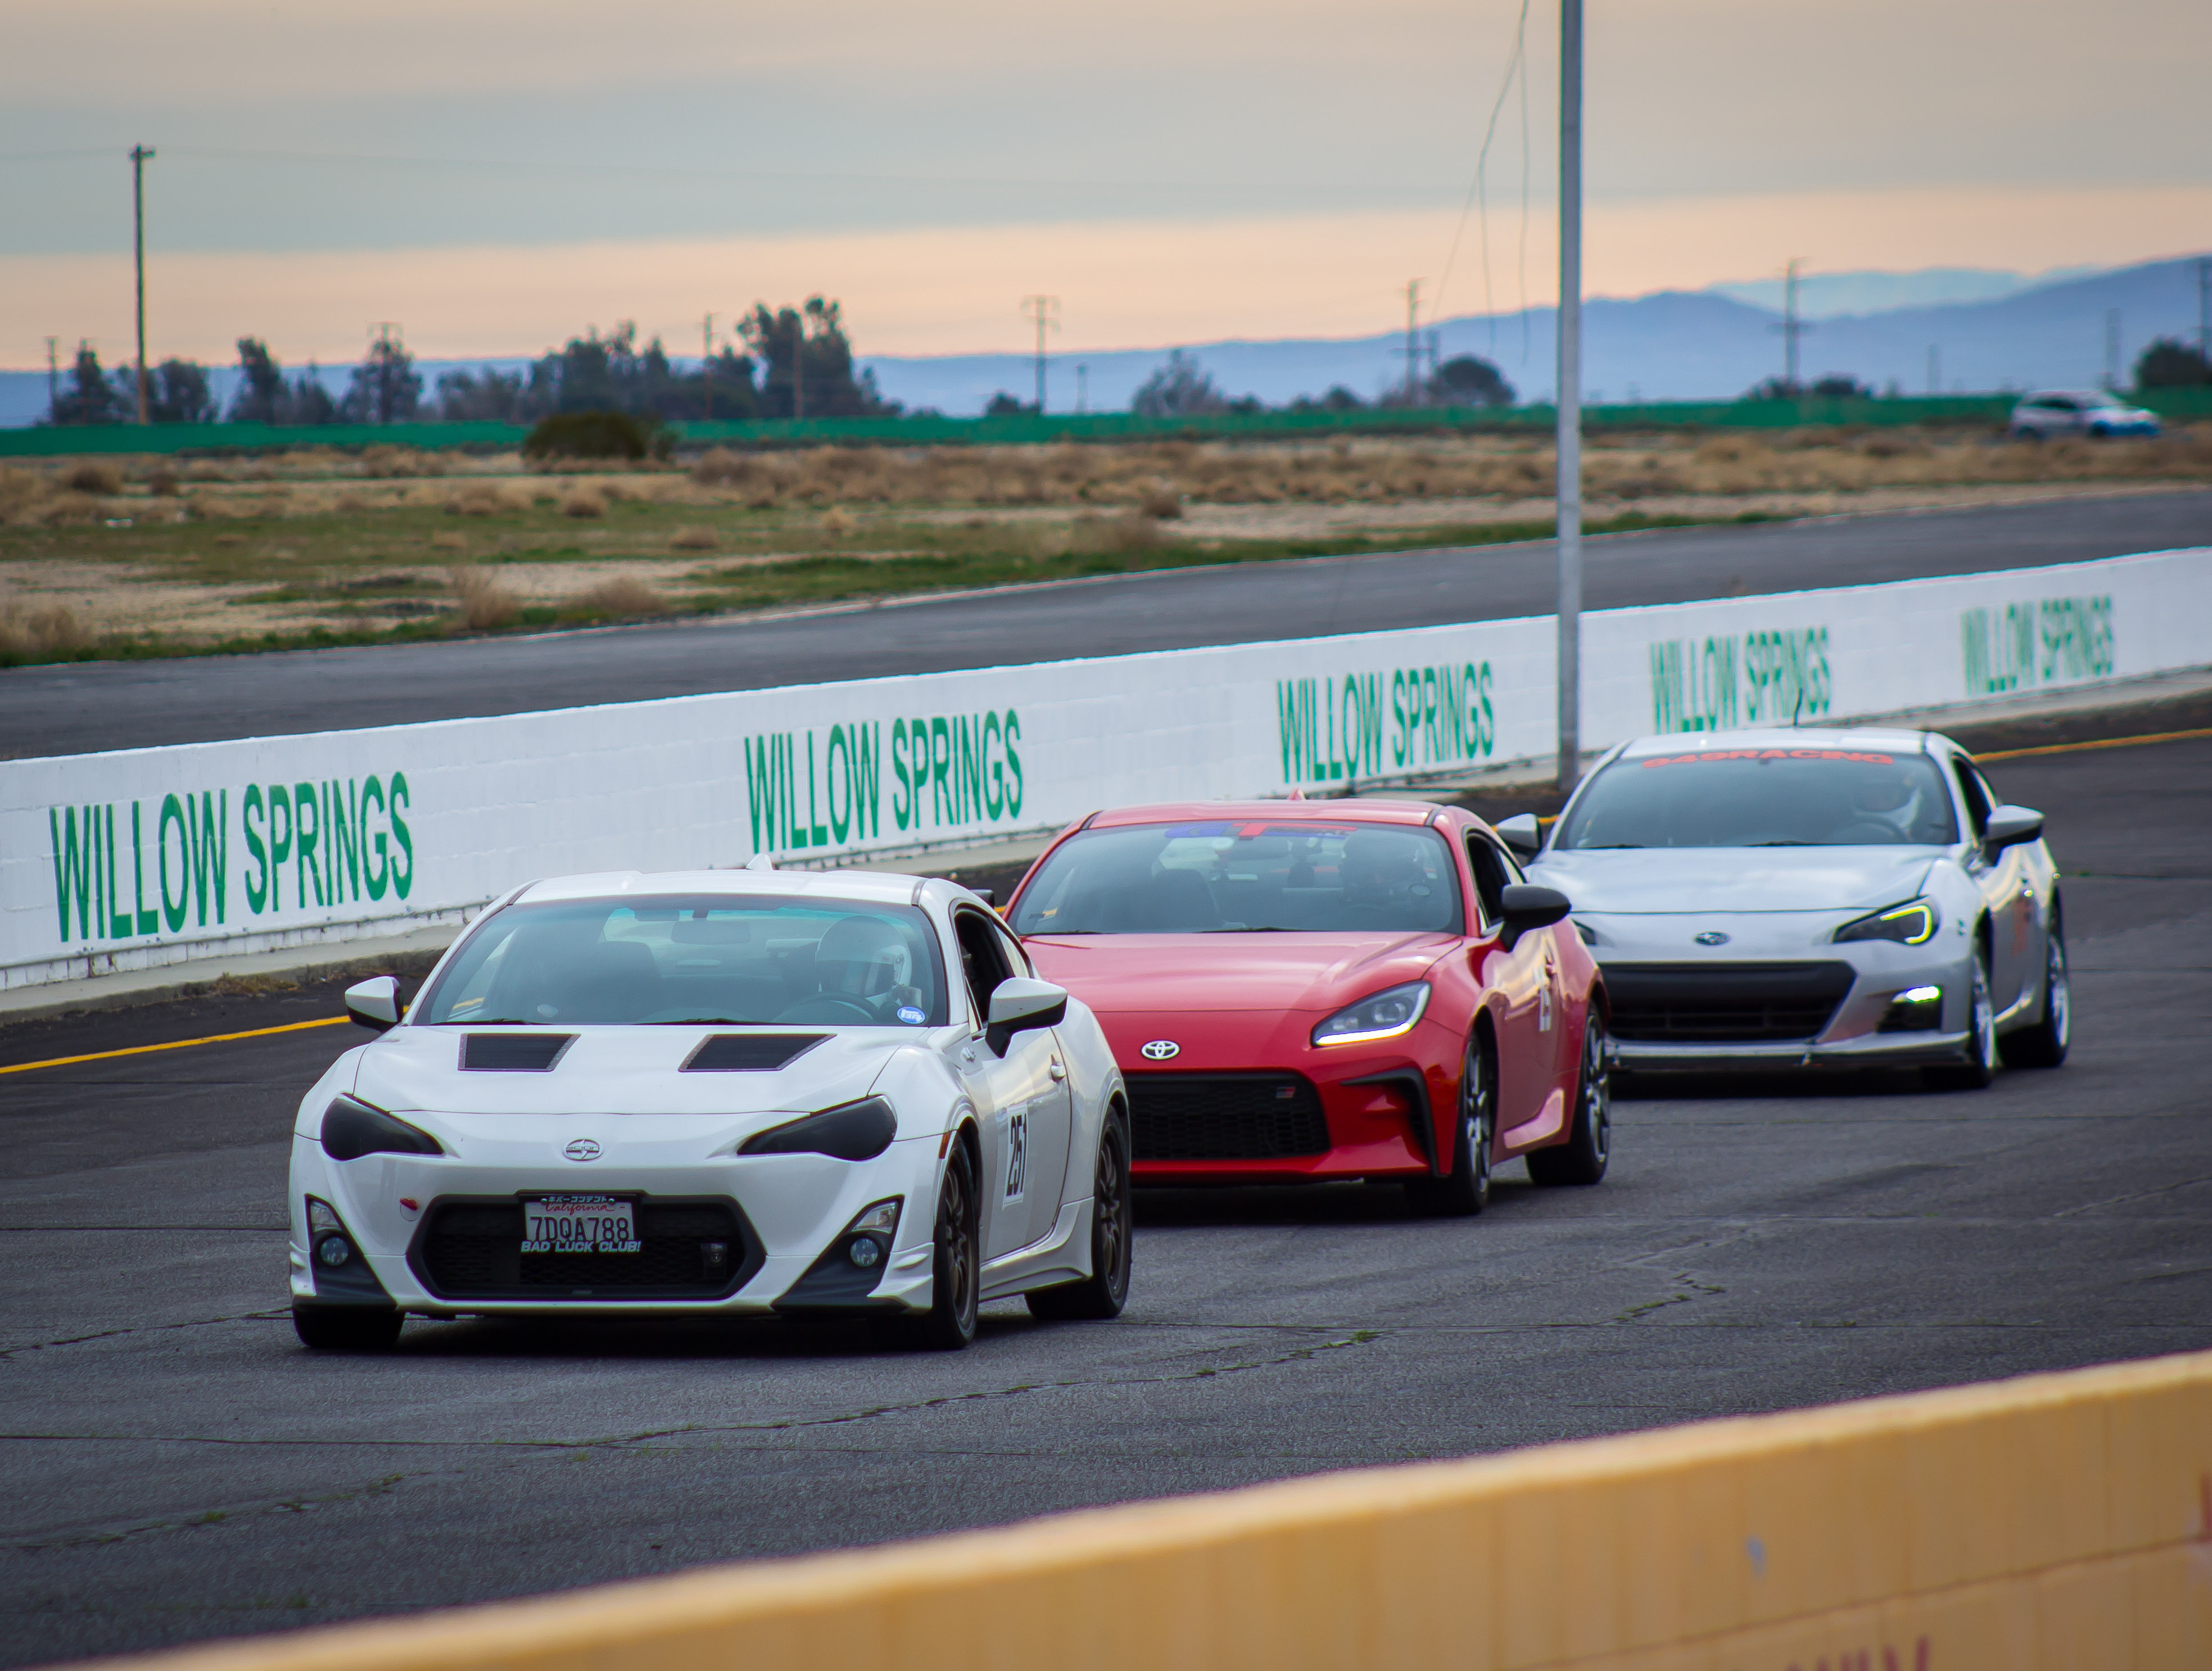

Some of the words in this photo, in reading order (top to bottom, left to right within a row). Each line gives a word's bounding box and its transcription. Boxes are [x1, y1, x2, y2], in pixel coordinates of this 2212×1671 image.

[1276, 672, 1383, 784] WILLOW
[1392, 660, 1494, 768] SPRINGS
[1650, 635, 1738, 734] WILLOW
[1744, 626, 1831, 722] SPRINGS
[744, 721, 880, 854] WILLOW
[892, 708, 1023, 831] SPRINGS
[49, 788, 227, 942] WILLOW
[243, 771, 413, 914] SPRINGS
[1006, 1113, 1027, 1197] 251
[521, 1240, 550, 1252] BAD
[555, 1240, 595, 1252] LUCK
[599, 1240, 641, 1252] CLUB!
[530, 1216, 630, 1242] 7DQA788
[545, 1202, 616, 1216] California
